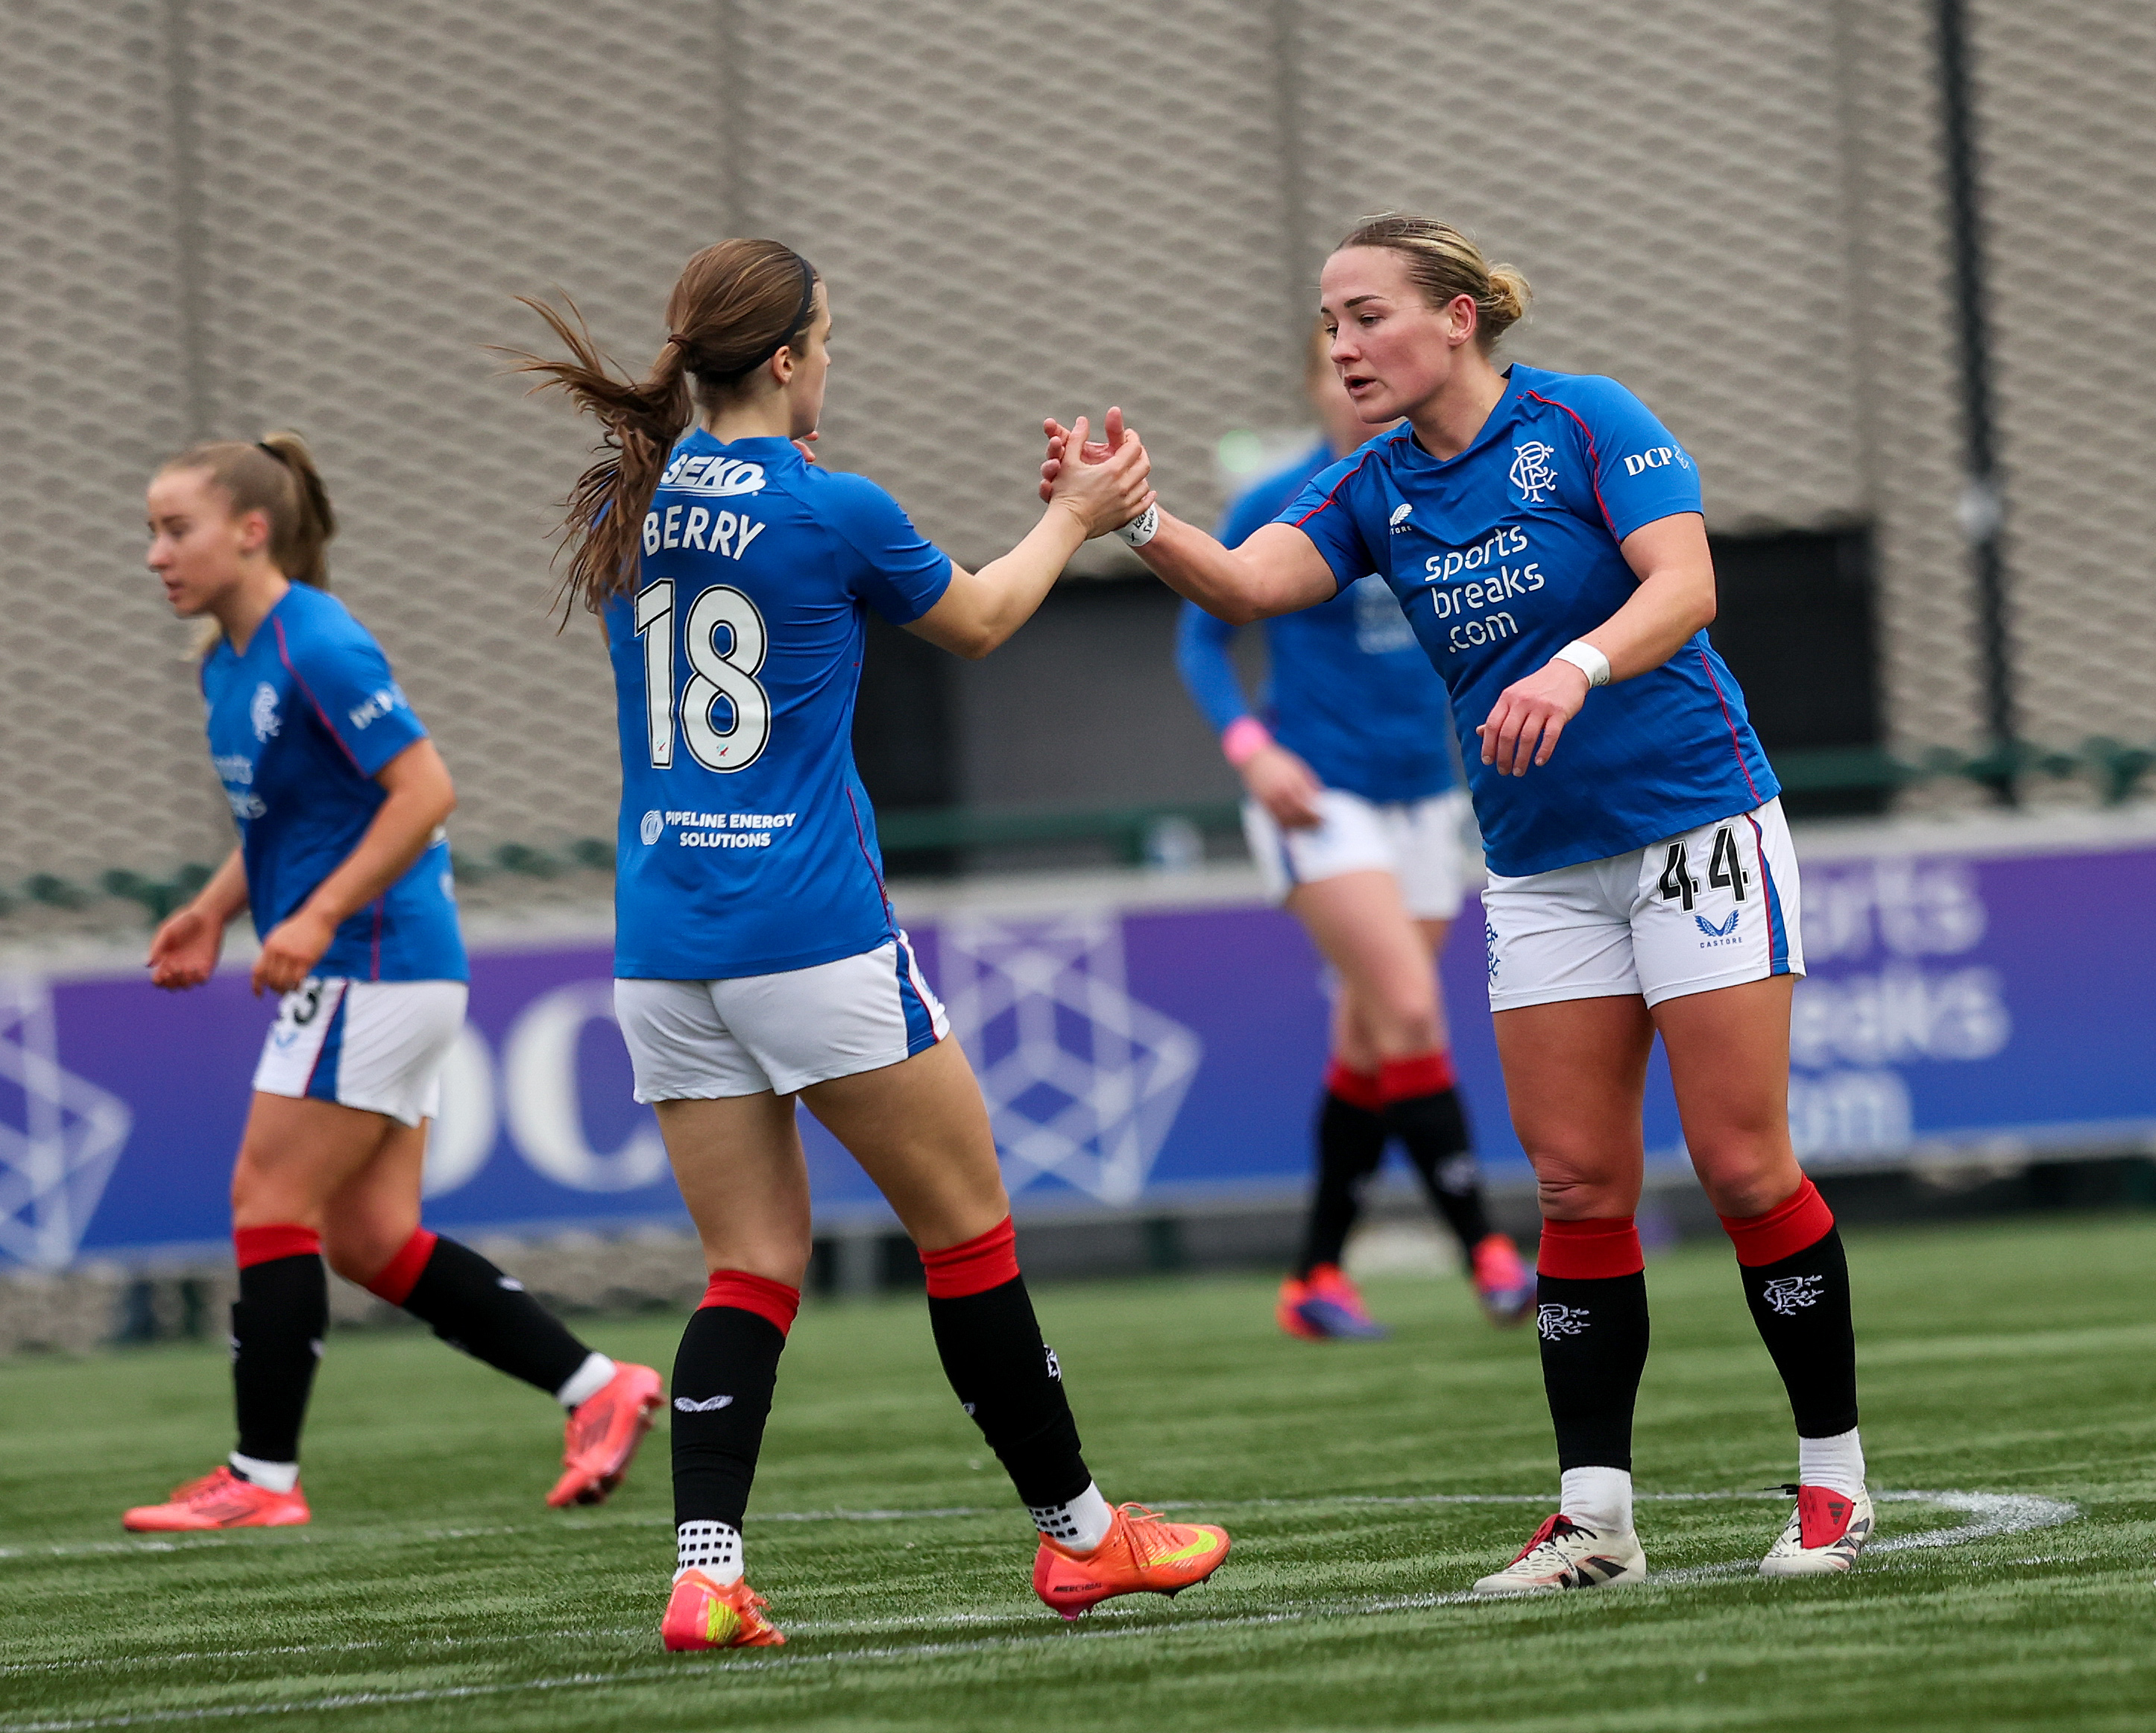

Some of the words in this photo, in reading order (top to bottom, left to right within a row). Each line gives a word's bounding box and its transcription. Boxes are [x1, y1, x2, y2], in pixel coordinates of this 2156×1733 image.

[660, 453, 767, 493] SEKO
[1624, 447, 1672, 477] DCP
[643, 504, 766, 561] BERRY
[1425, 525, 1528, 582] sports
[1431, 563, 1545, 619] breaks
[1449, 611, 1519, 653] .com
[635, 578, 771, 773] 18
[666, 811, 727, 828] PIPELINE
[730, 813, 796, 828] ENERGY
[680, 832, 771, 849] SOLUTIONS
[1657, 825, 1750, 914] 44
[1700, 937, 1742, 949] CASTORE
